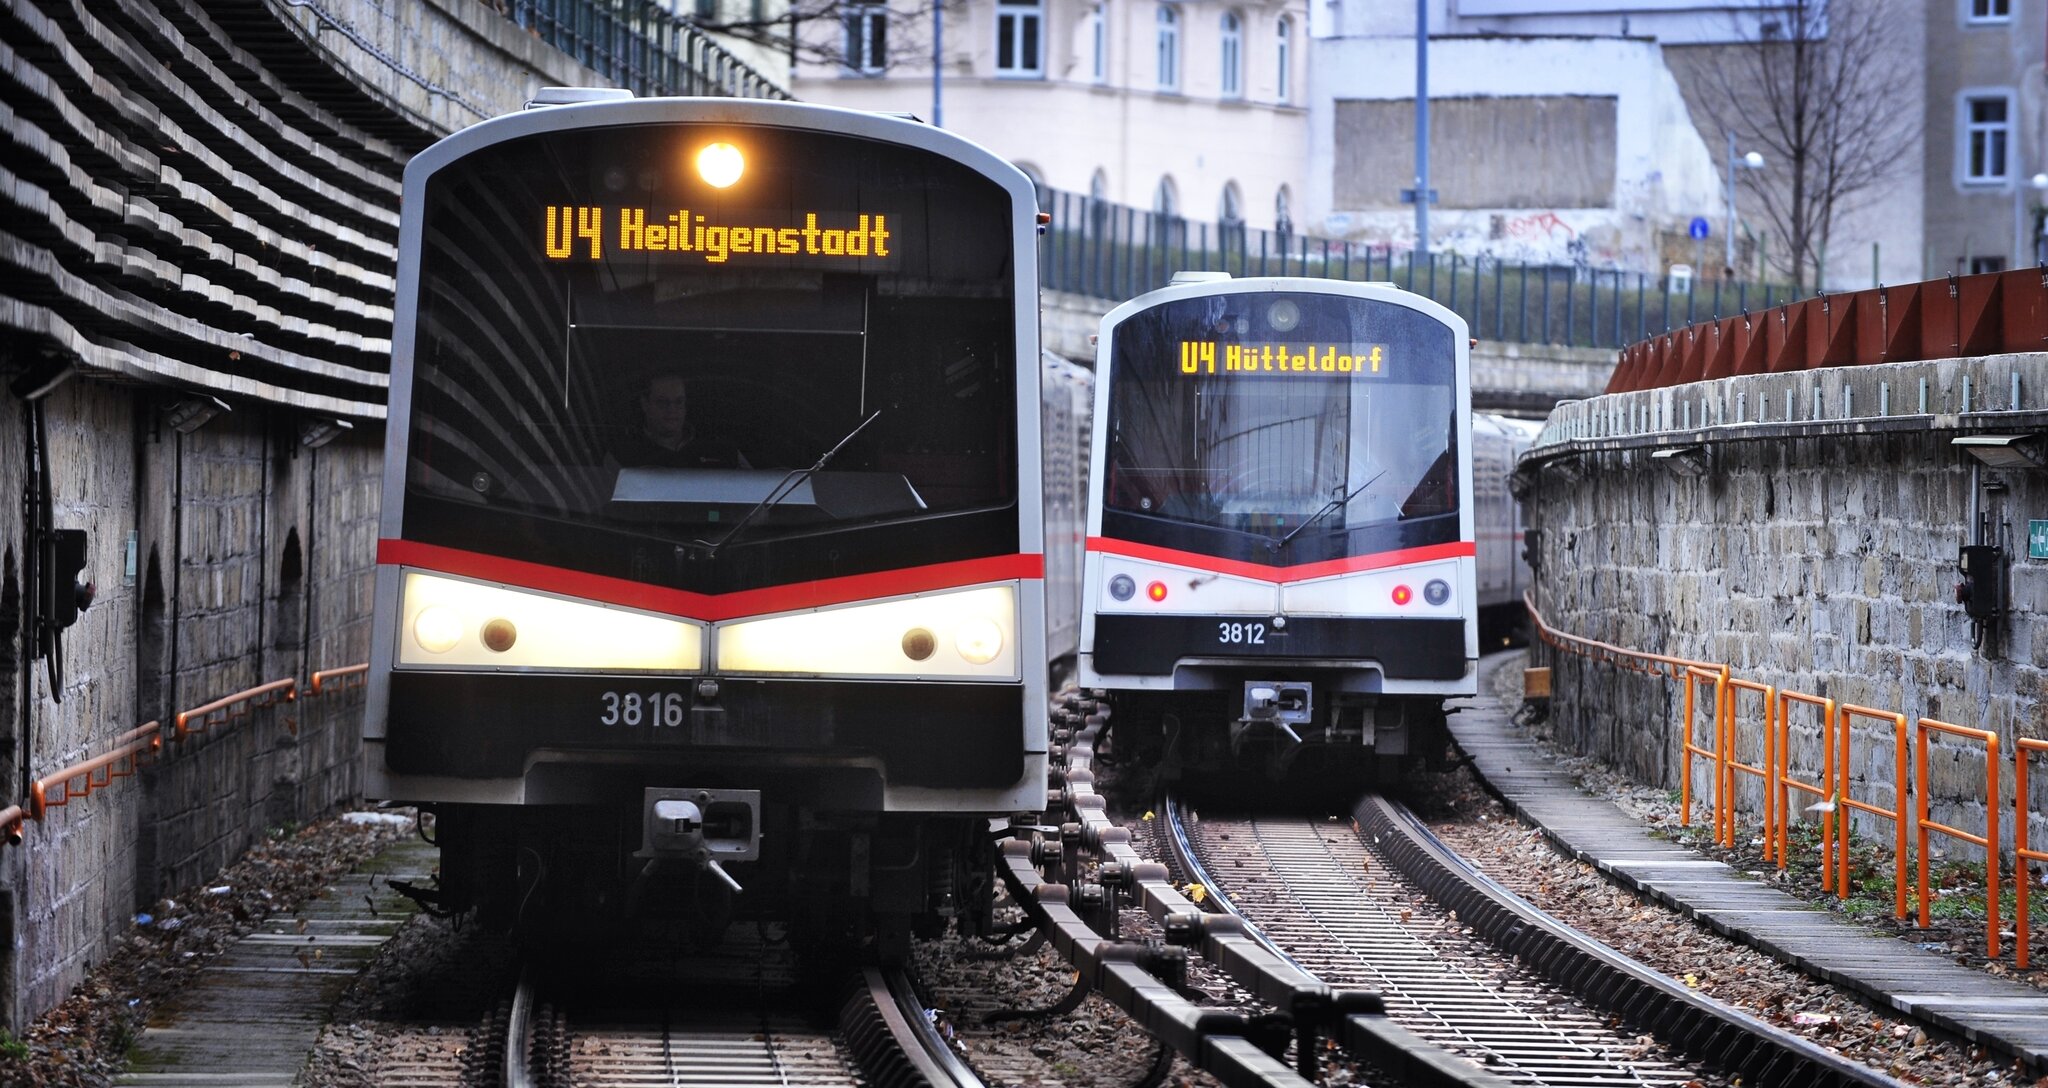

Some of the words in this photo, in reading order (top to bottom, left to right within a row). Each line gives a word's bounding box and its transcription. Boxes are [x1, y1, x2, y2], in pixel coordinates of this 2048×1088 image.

[546, 206, 601, 259] U4
[620, 207, 890, 263] Heiligenstadt
[1181, 341, 1215, 373] U4
[1226, 345, 1382, 372] Hütteldorf
[1218, 622, 1265, 644] 3812
[600, 691, 683, 727] 3816
